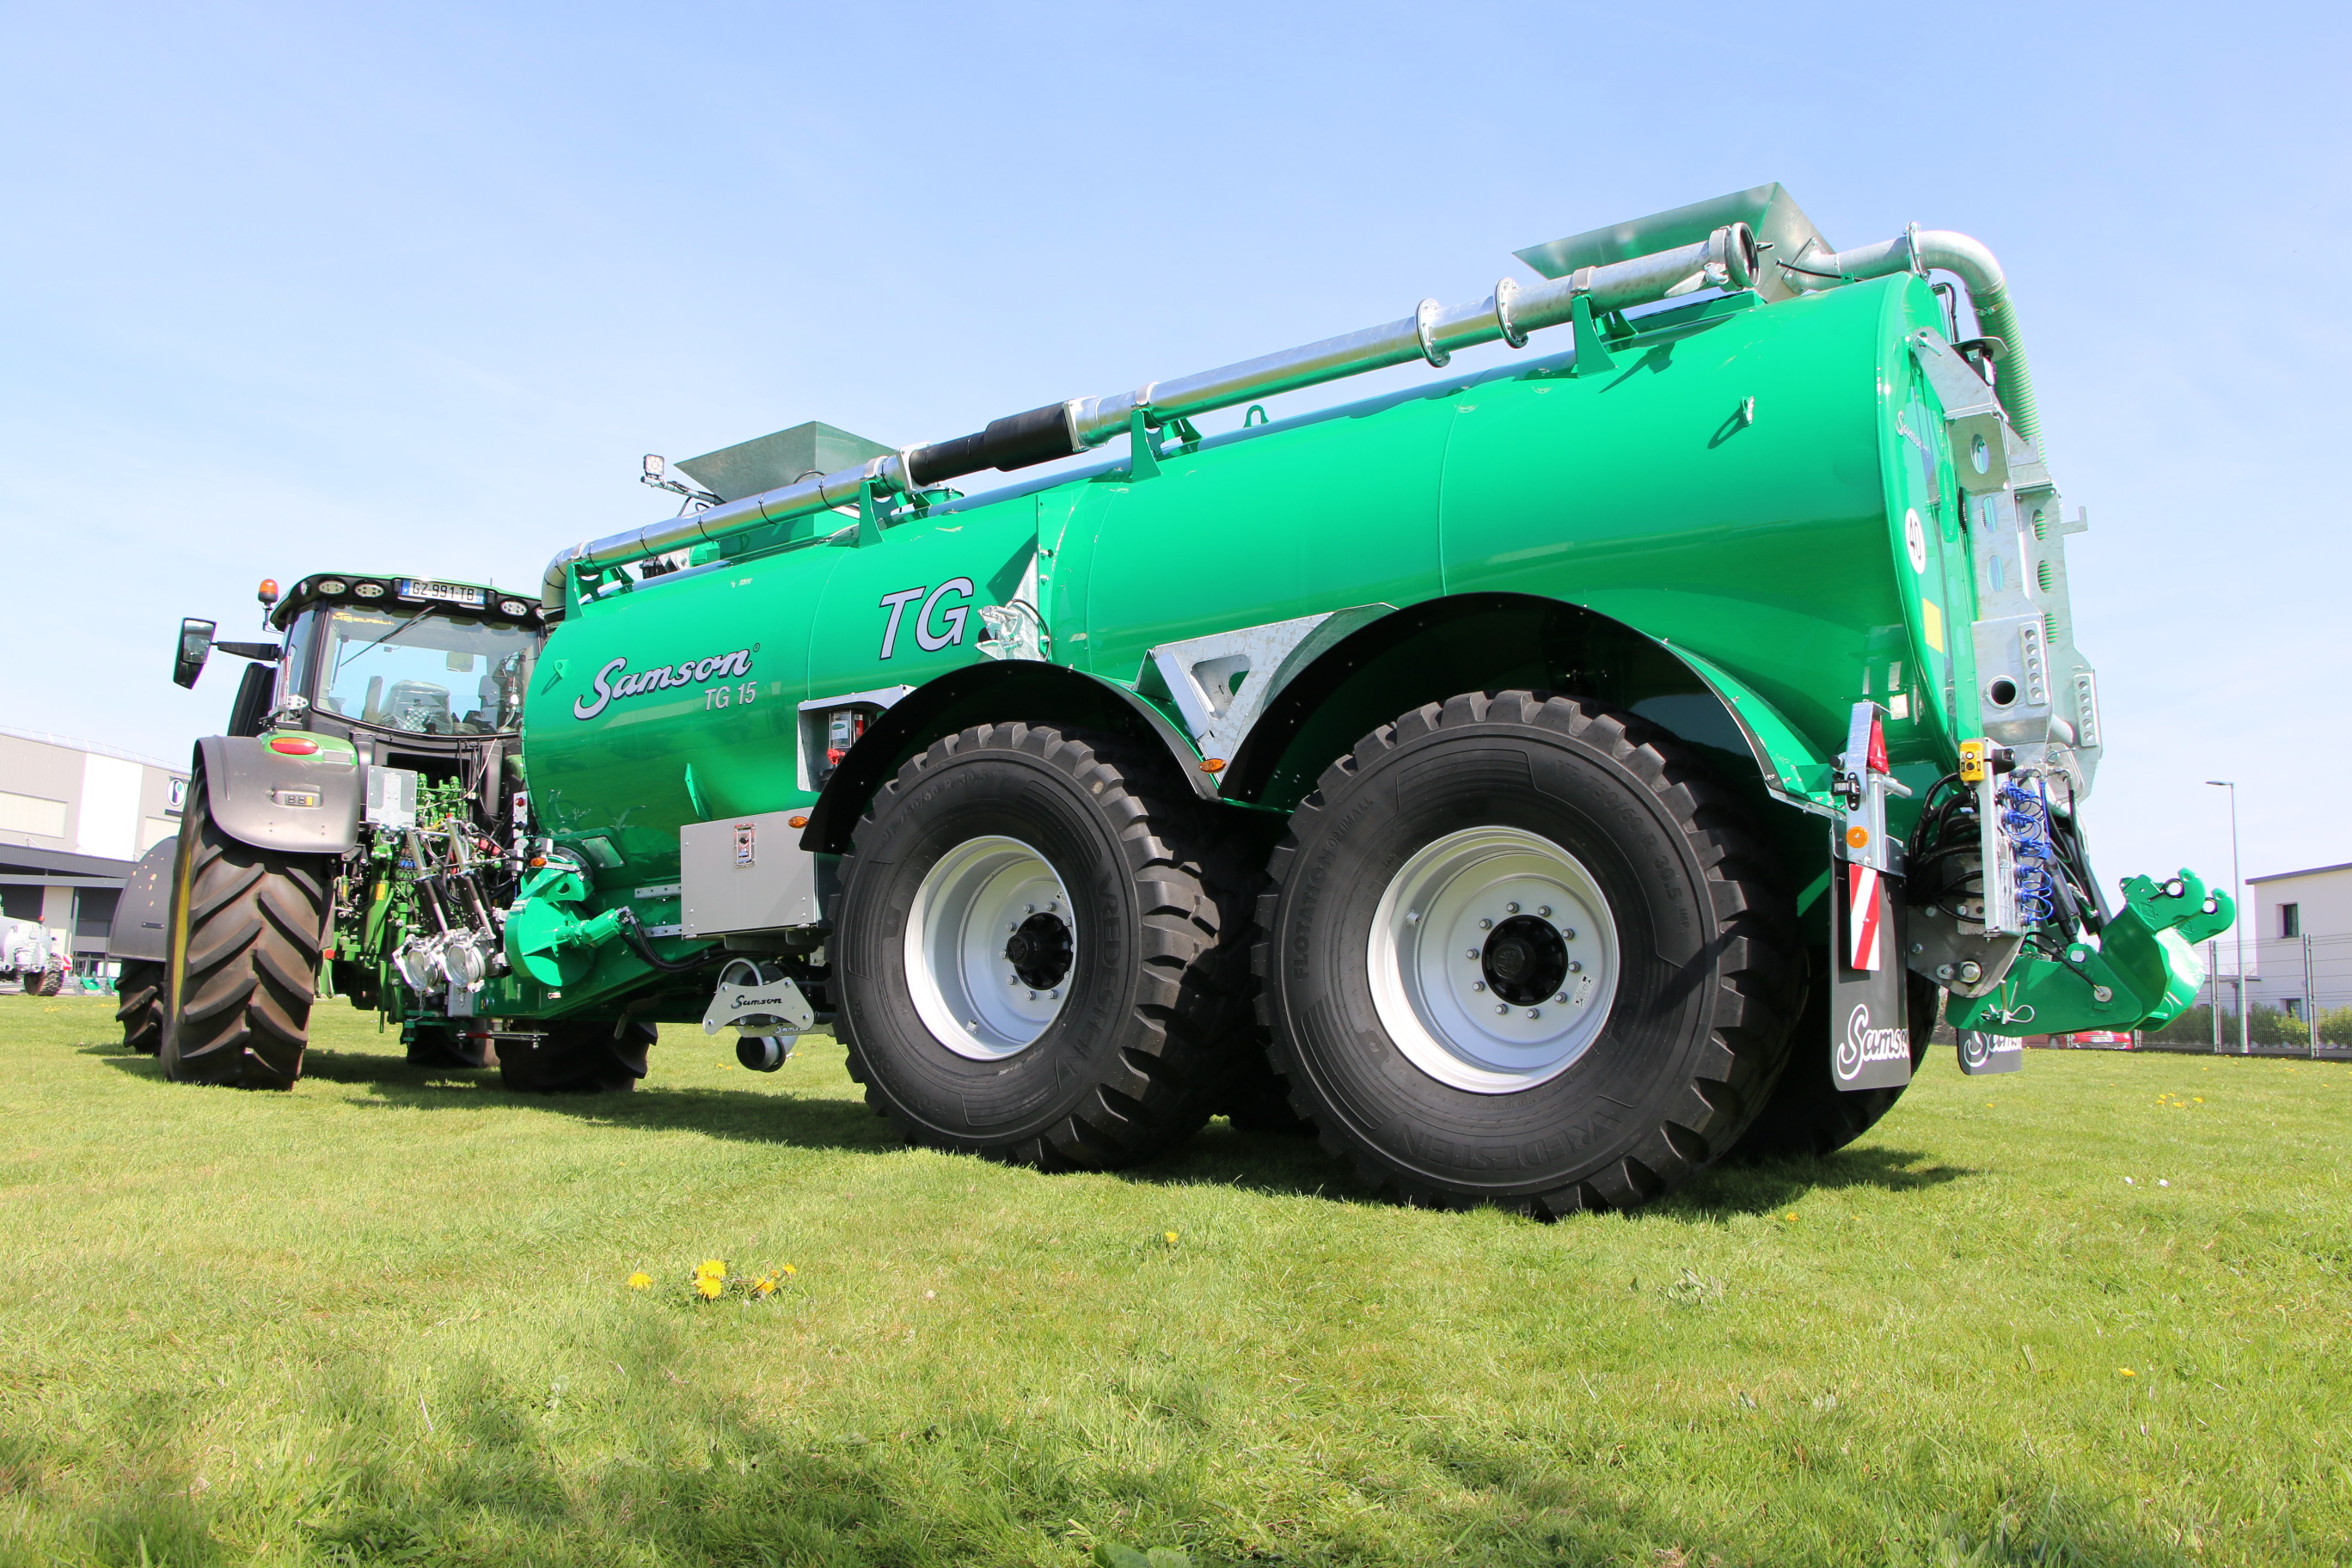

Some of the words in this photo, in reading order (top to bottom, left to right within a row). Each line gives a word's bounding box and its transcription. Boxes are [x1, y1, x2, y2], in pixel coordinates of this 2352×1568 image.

[1909, 517, 1922, 560] 40
[413, 581, 475, 601] GZ-991-TB
[879, 576, 975, 661] TG
[573, 648, 754, 721] Samson
[704, 685, 732, 712] TG
[737, 681, 757, 706] 15
[1292, 848, 1336, 981] FLOTATION
[731, 994, 783, 1010] Samson
